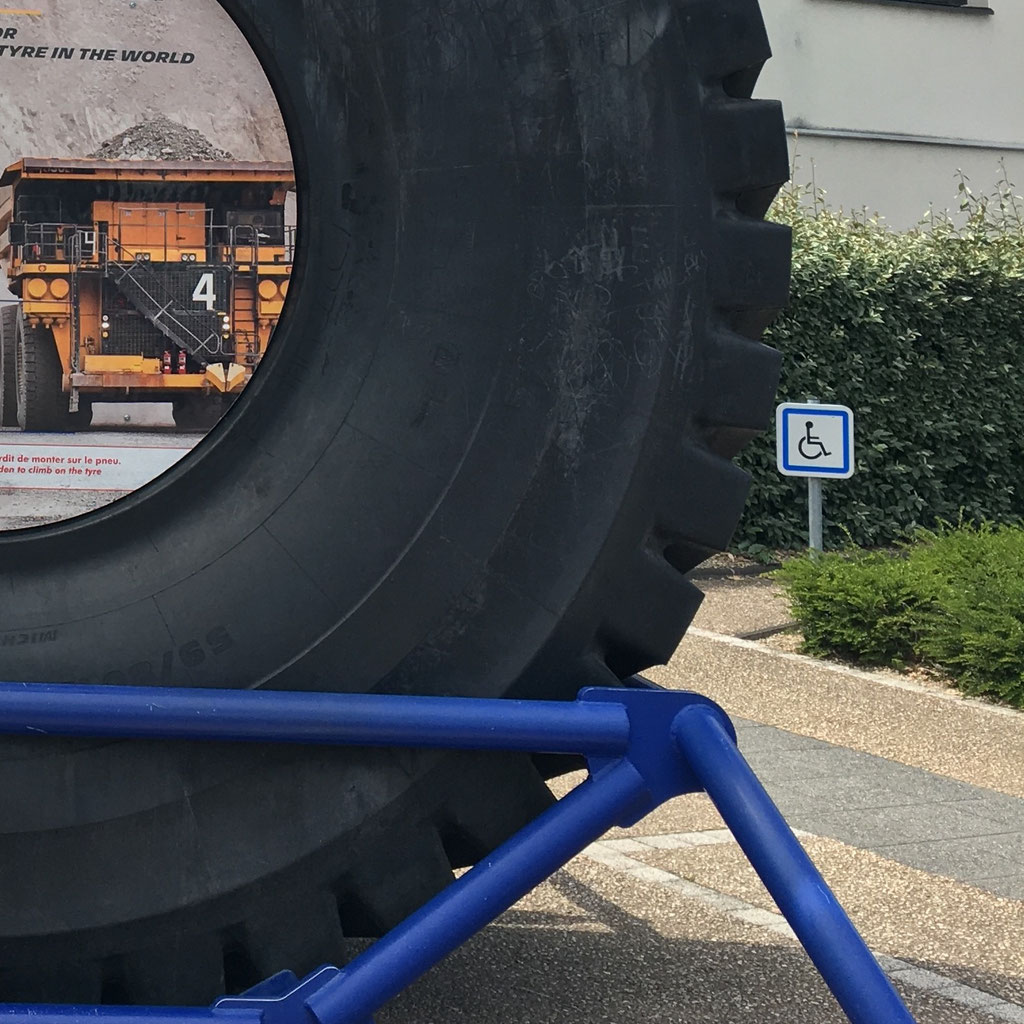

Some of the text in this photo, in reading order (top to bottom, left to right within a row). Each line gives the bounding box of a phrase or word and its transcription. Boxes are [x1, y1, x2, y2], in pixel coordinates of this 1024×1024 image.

[51, 47, 75, 60] IN
[80, 48, 117, 61] THE
[121, 49, 195, 64] WORLD
[192, 273, 216, 311] 4
[17, 454, 29, 463] de
[31, 455, 65, 464] monter
[67, 456, 82, 465] sur
[84, 456, 93, 465] le
[95, 457, 122, 467] pneu.
[17, 466, 26, 474] to
[28, 466, 53, 475] climb
[55, 467, 66, 475] on
[68, 466, 83, 475] the
[84, 467, 102, 477] tyre
